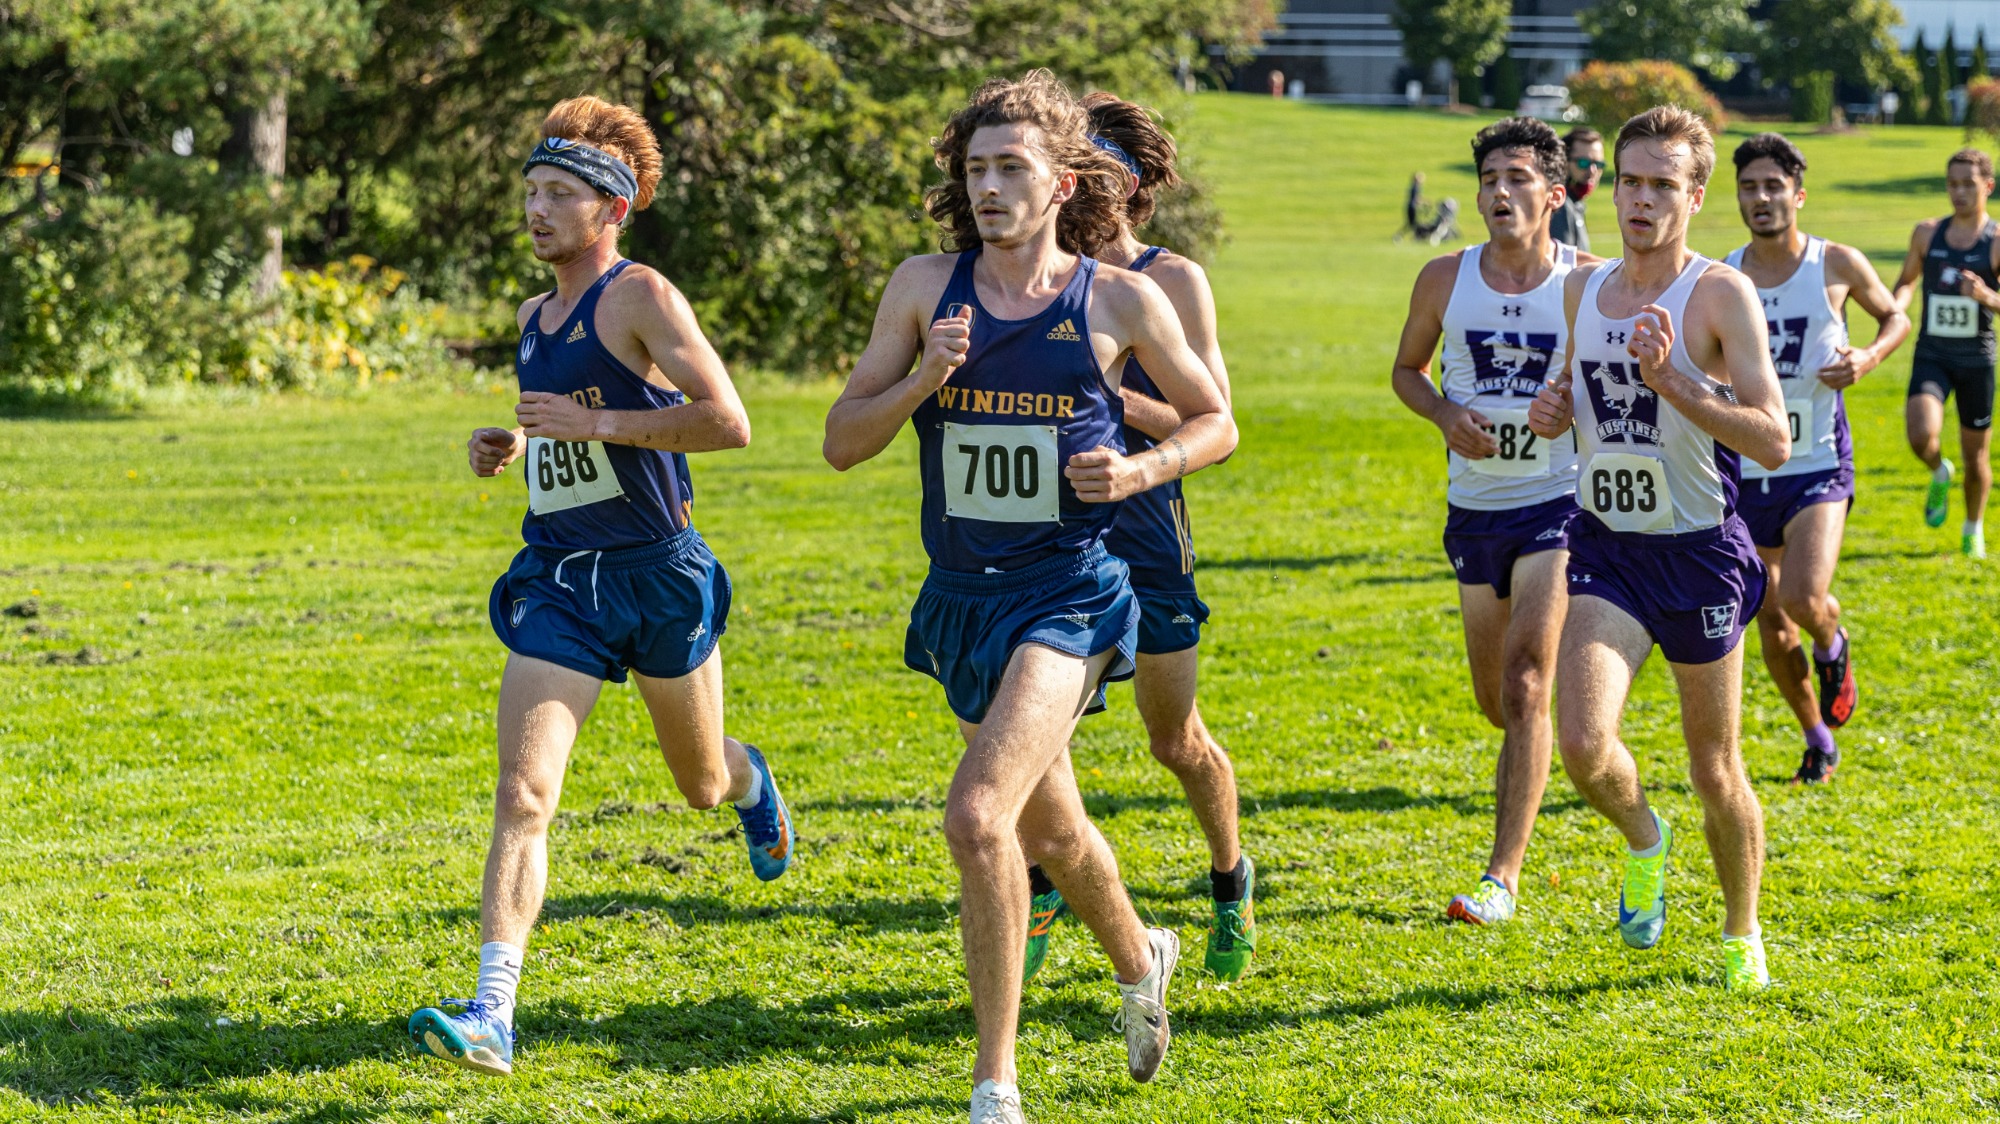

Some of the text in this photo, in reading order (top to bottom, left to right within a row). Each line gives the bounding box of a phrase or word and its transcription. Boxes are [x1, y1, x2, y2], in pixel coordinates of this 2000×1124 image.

[1937, 306, 1968, 327] 633
[567, 331, 587, 344] adidas
[1047, 331, 1081, 341] adidas
[937, 386, 1075, 418] WINDSOR
[1597, 420, 1659, 441] MUSTANGS
[538, 441, 598, 492] 698
[958, 444, 1039, 498] 700
[1592, 469, 1657, 513] 683
